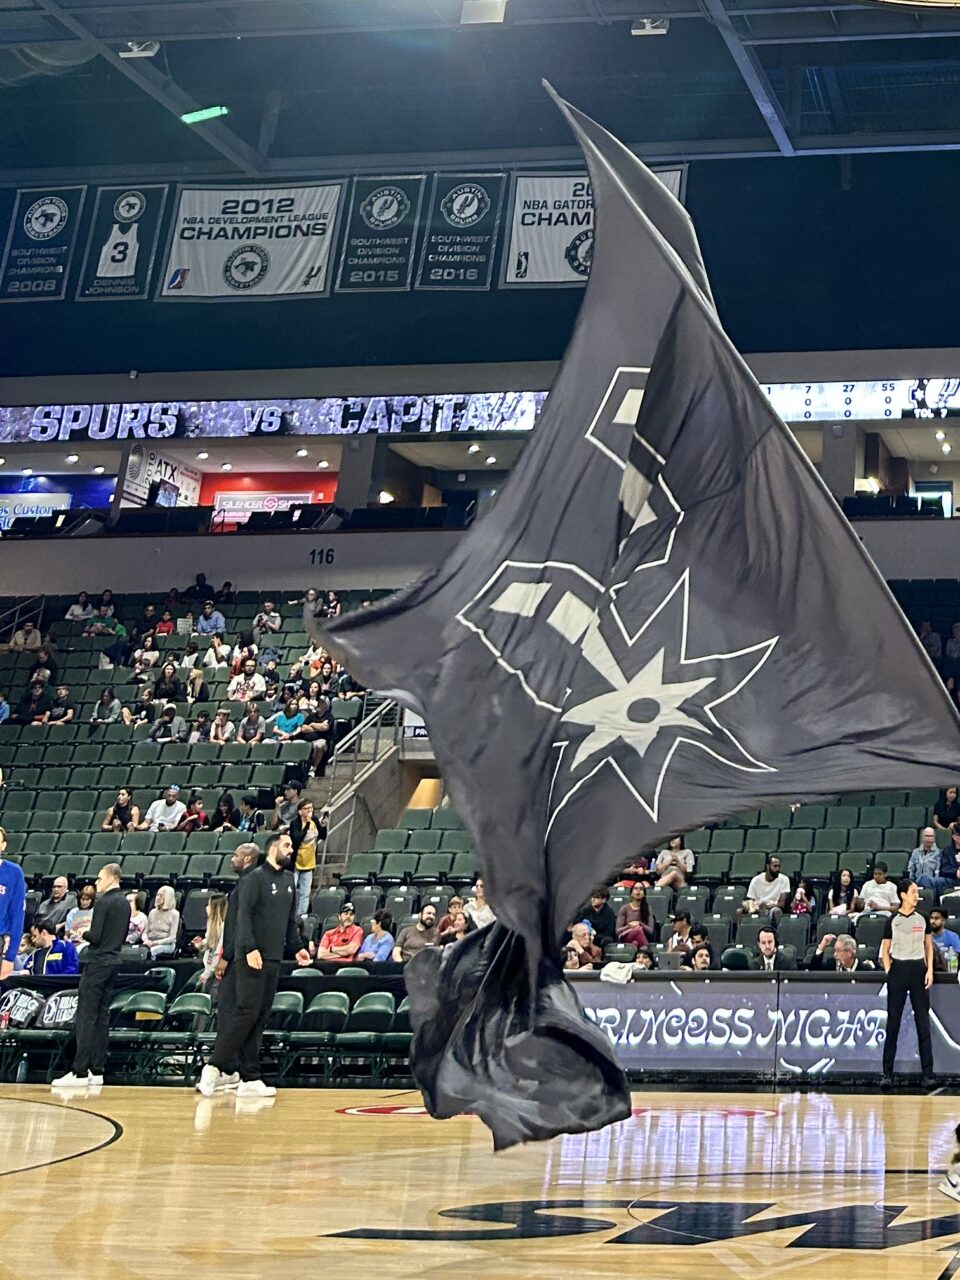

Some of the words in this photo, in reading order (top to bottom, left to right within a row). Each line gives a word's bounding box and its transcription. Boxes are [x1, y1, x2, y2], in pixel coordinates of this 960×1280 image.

[371, 186, 402, 203] AUSTIN
[451, 185, 482, 200] AUSTIN
[221, 197, 295, 215] 2012
[523, 200, 548, 211] NBA
[182, 216, 205, 225] NBA
[207, 215, 284, 225] DEVELOPMENT
[287, 212, 329, 222] LEAGUE
[369, 217, 399, 227] SPURS
[450, 215, 479, 225] SPURS
[179, 222, 328, 241] CHAMPIONS
[350, 236, 409, 246] SOUTHWEST
[431, 235, 490, 244] SOUTHWEST
[10, 246, 68, 257] SOUTHWEST
[110, 241, 129, 264] 3
[357, 246, 400, 255] DIVISION
[438, 245, 480, 253] DIVISION
[16, 256, 58, 265] DIVISION
[347, 255, 406, 265] CHAMPIONS
[428, 254, 486, 263] CHAMPIONS
[7, 265, 63, 275] CHAMPIONS
[429, 268, 478, 281] 2016
[350, 270, 400, 282] 2015
[7, 279, 57, 293] 2008
[92, 278, 136, 287] DENNIS
[84, 285, 140, 295] JOHNSON
[805, 385, 812, 395] 7
[842, 384, 855, 393] 27
[881, 383, 895, 392] 55
[29, 402, 181, 441] SPURS
[244, 406, 282, 433] VS
[153, 458, 178, 483] ATX
[222, 500, 263, 509] SILENCER
[308, 548, 335, 566] 116
[755, 1008, 888, 1047] NIGHT
